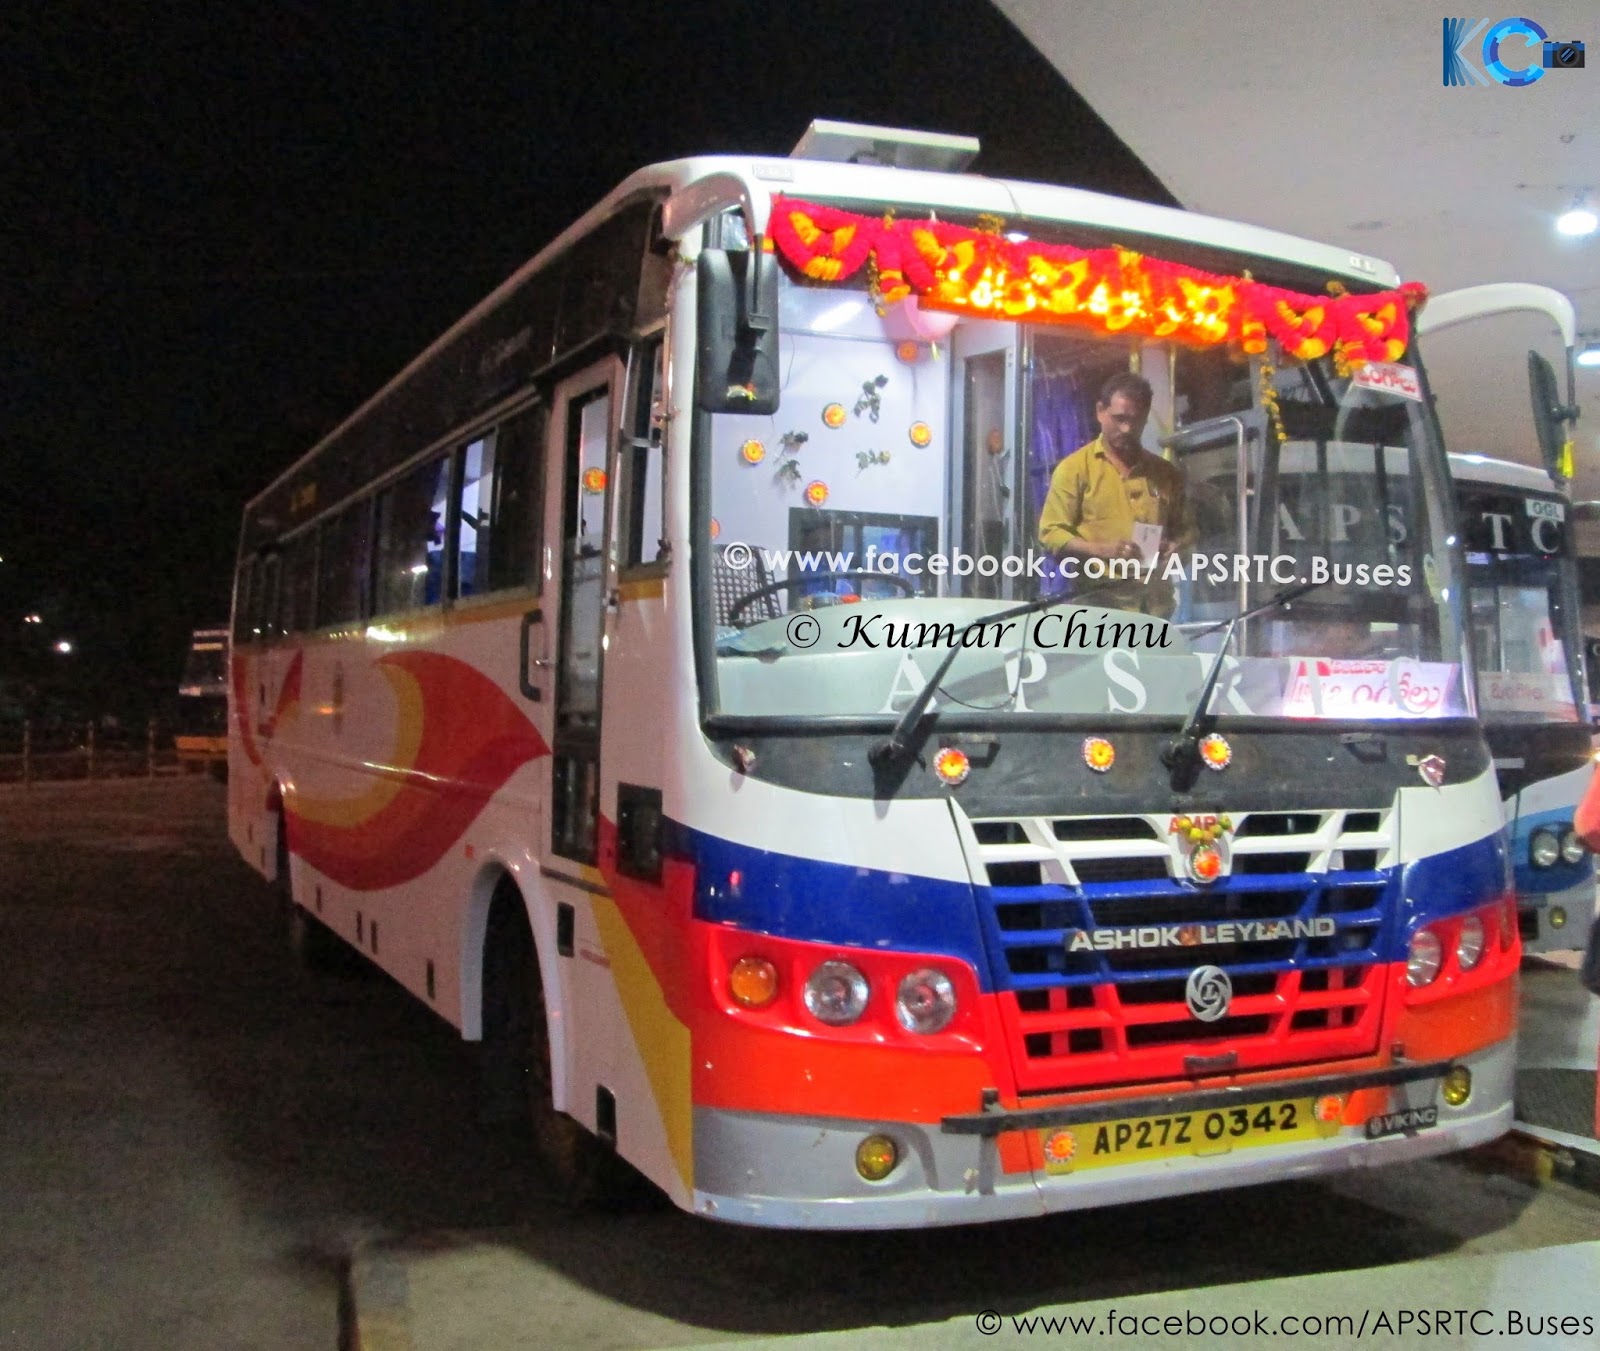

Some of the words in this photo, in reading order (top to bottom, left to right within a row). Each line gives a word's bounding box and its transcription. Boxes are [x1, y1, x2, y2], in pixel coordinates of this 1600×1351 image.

[1070, 926, 1181, 951] ASHOK
[1200, 918, 1335, 945] LEYLAND
[1093, 1115, 1192, 1155] AP27Z
[1203, 1103, 1298, 1141] 0342
[1384, 1108, 1437, 1131] VIKING
